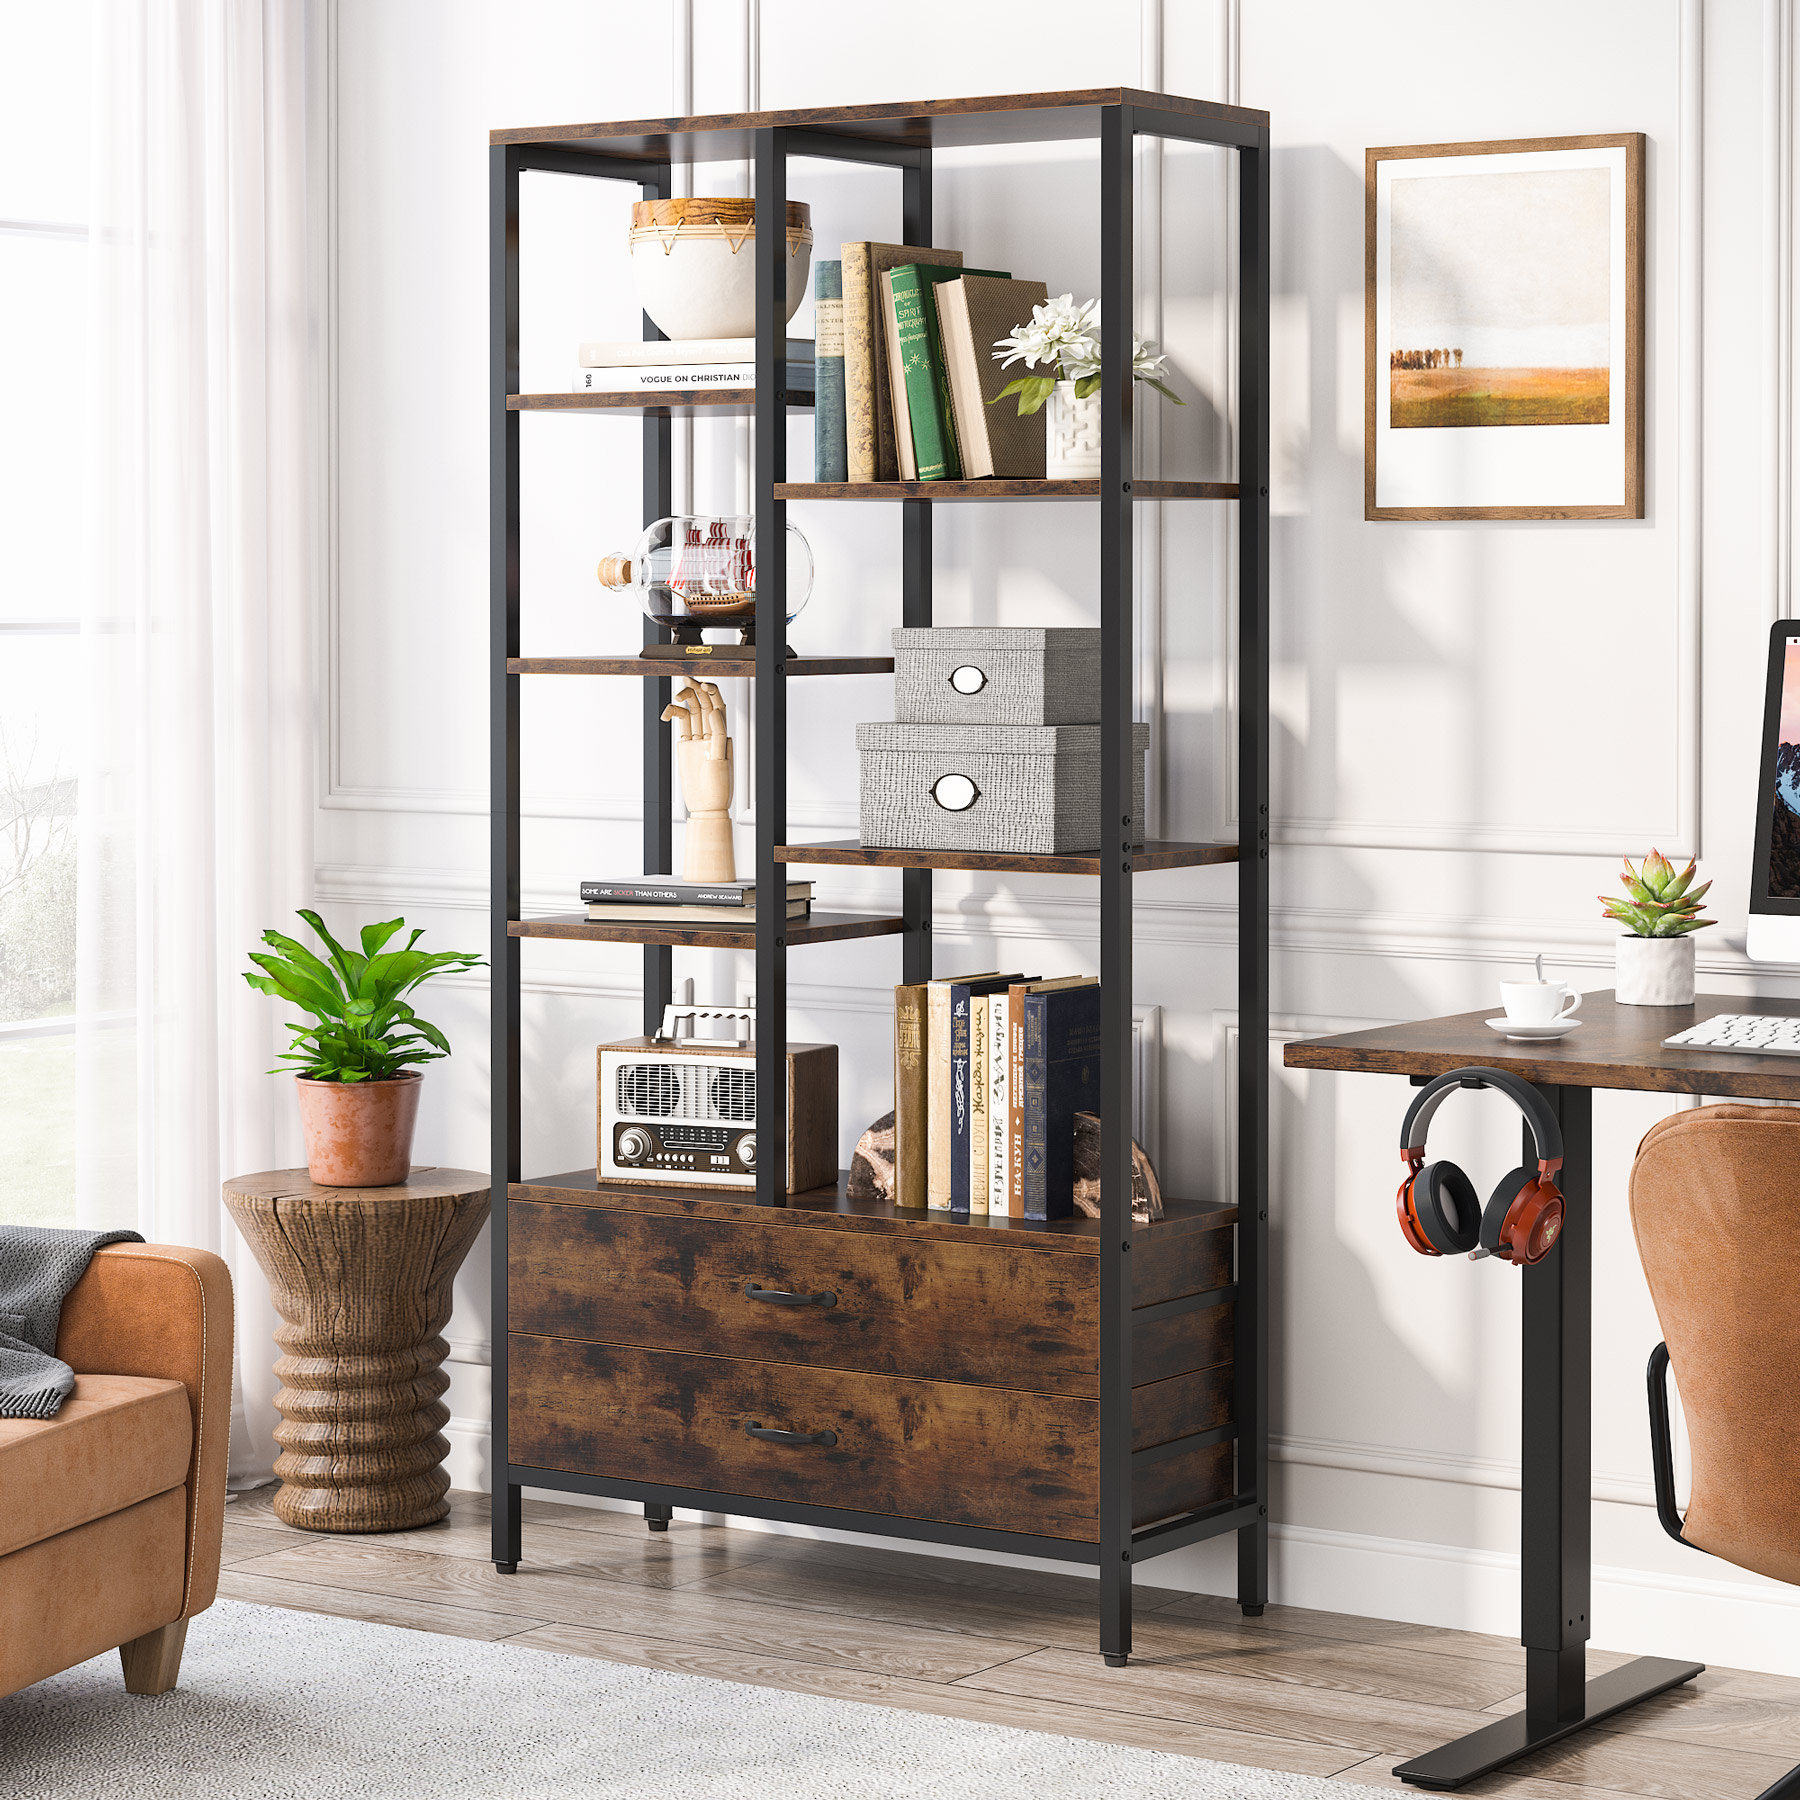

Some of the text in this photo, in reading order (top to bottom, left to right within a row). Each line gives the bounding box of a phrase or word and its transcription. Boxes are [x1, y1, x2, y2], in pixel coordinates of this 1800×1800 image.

[640, 373, 756, 384] VOGUE ON CHRISTIAN DIO
[613, 889, 634, 897] SICKER
[635, 890, 652, 898] THAN
[653, 891, 677, 899] OTHERS
[972, 1007, 985, 1114] Жажда жизни
[973, 1119, 985, 1205] ИРВИНГ СТОУН
